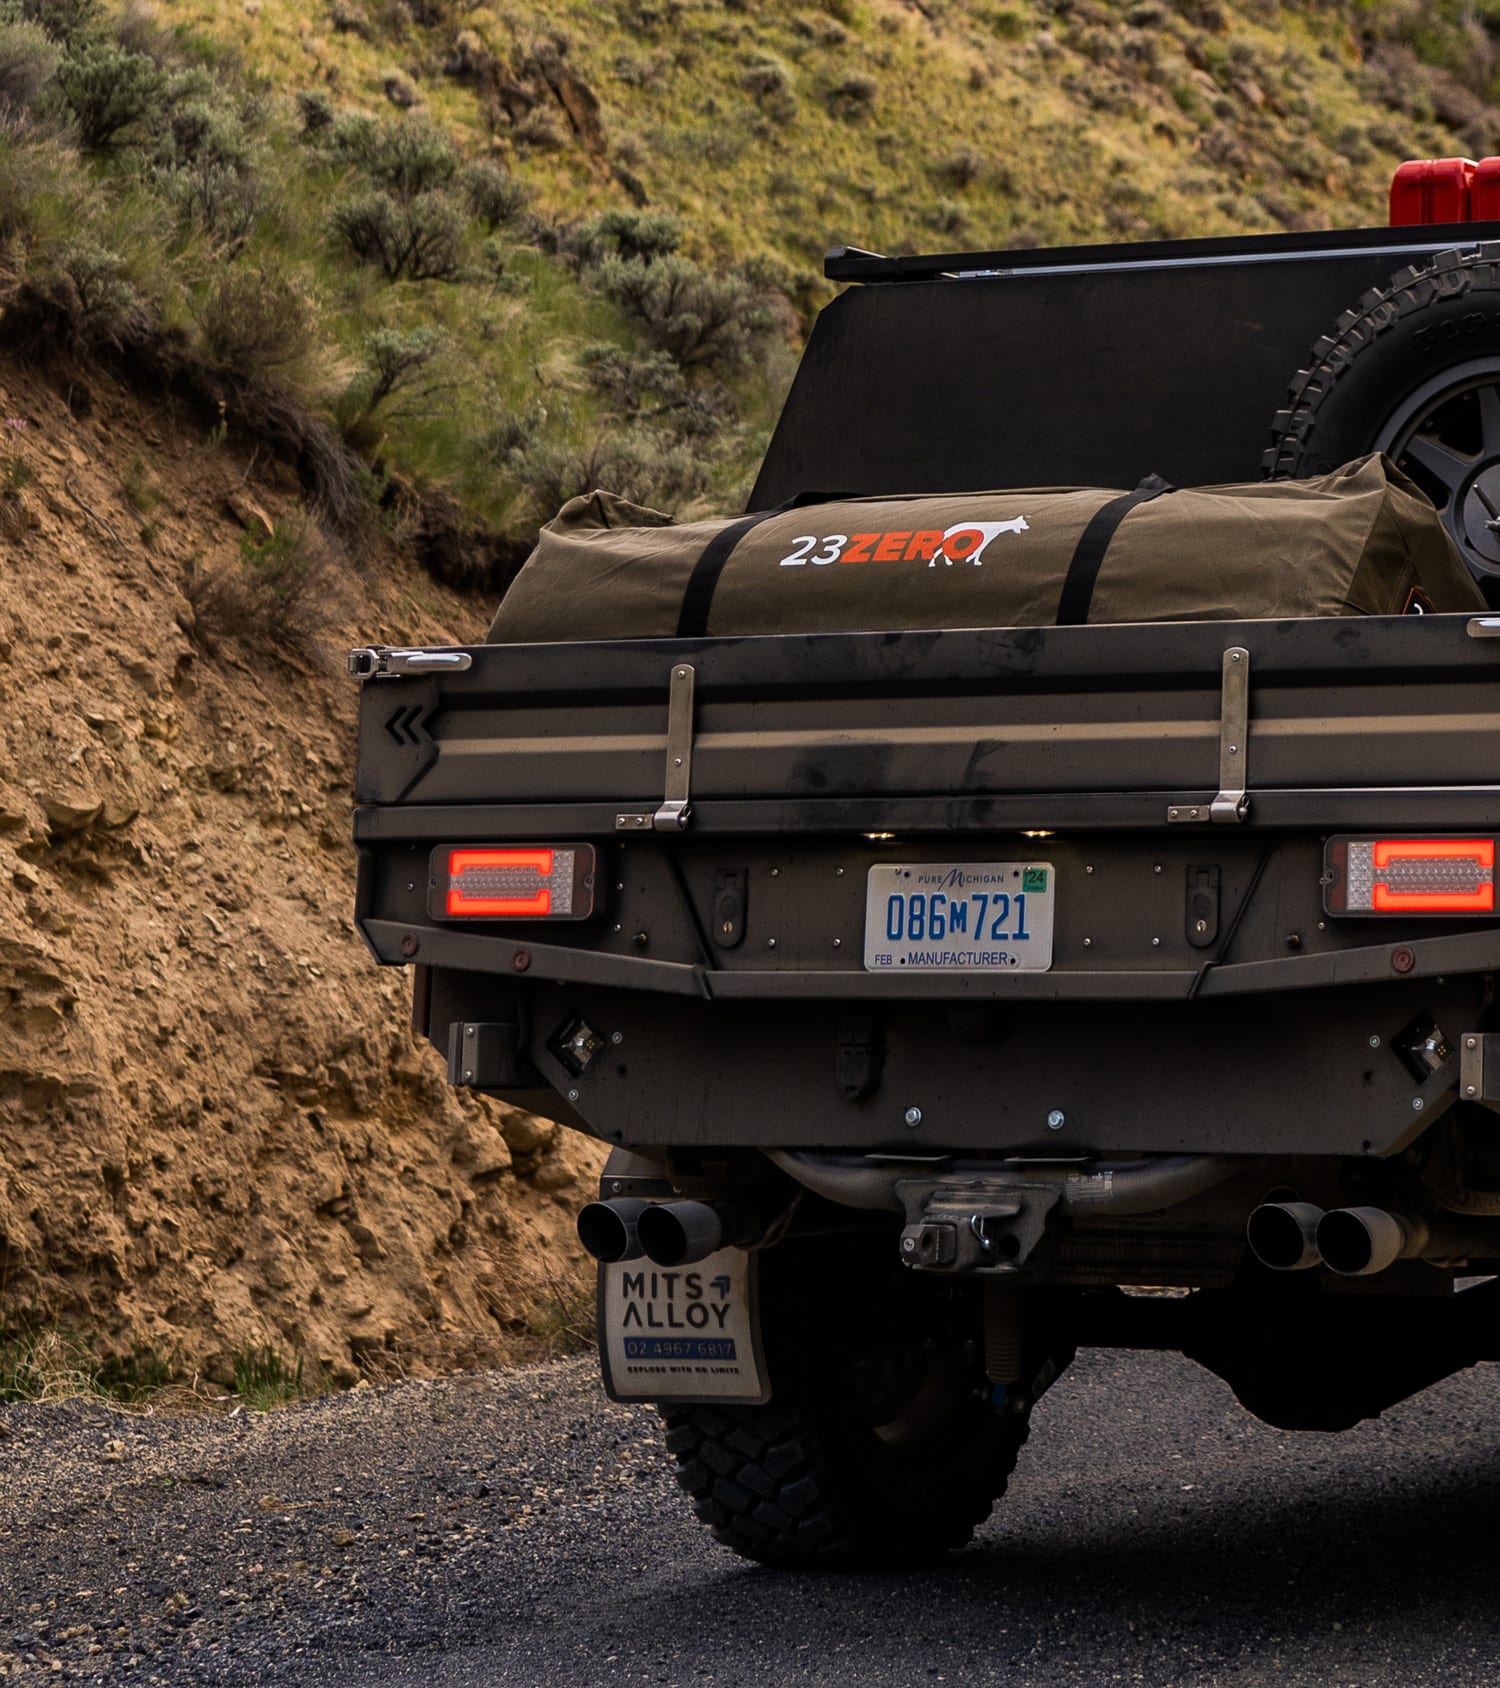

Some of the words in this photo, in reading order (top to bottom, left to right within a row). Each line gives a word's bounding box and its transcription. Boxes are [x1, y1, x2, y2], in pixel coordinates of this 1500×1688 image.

[780, 529, 984, 566] 23ZERO
[918, 875, 943, 884] PURE
[938, 868, 1004, 891] MICHIGAN
[886, 894, 1030, 940] 086M721
[874, 954, 893, 965] FEB
[908, 951, 1008, 966] MANUFACTURER
[622, 1271, 703, 1300] MITS
[622, 1301, 730, 1329] ALLOY
[627, 1342, 647, 1355] 02
[670, 1366, 692, 1374] WITH
[711, 1367, 740, 1375] LIMITS
